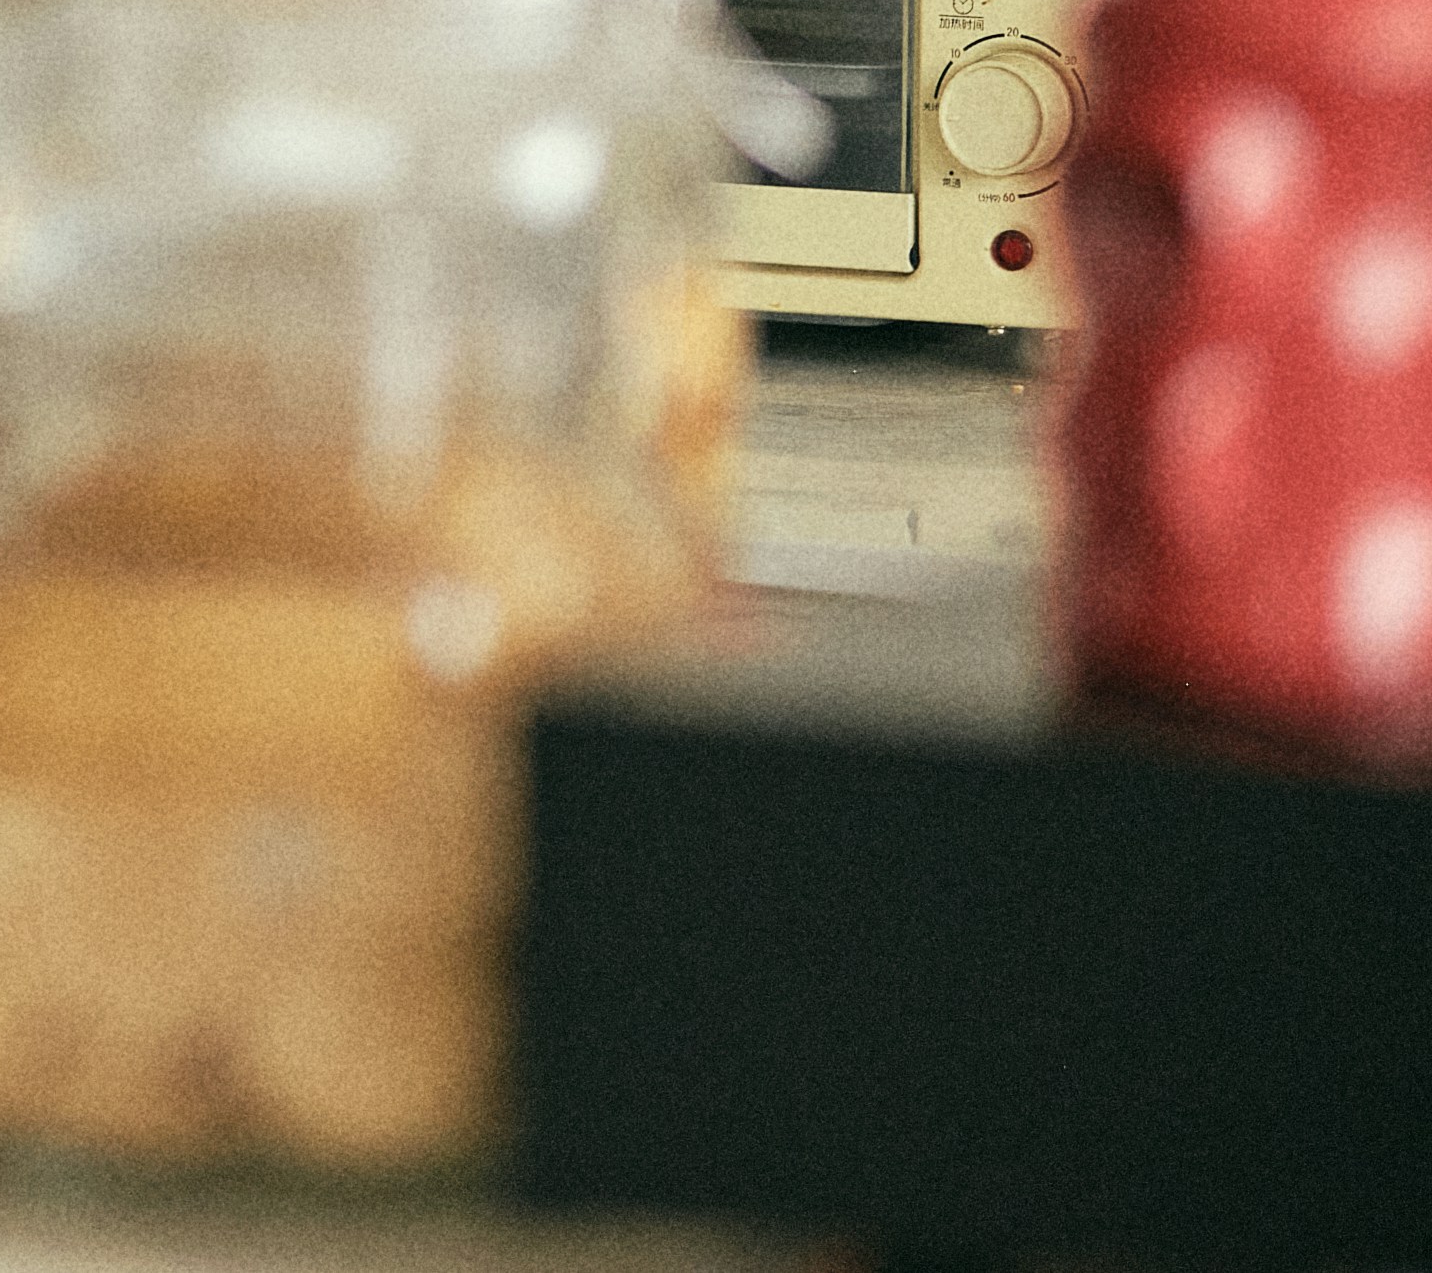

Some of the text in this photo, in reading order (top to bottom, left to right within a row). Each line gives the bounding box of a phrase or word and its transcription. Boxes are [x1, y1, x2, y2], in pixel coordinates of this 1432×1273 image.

[939, 18, 985, 31] 加热时间
[1007, 27, 1020, 37] 20
[951, 48, 961, 58] 10
[1064, 56, 1077, 66] 30
[1003, 192, 1016, 203] 60
